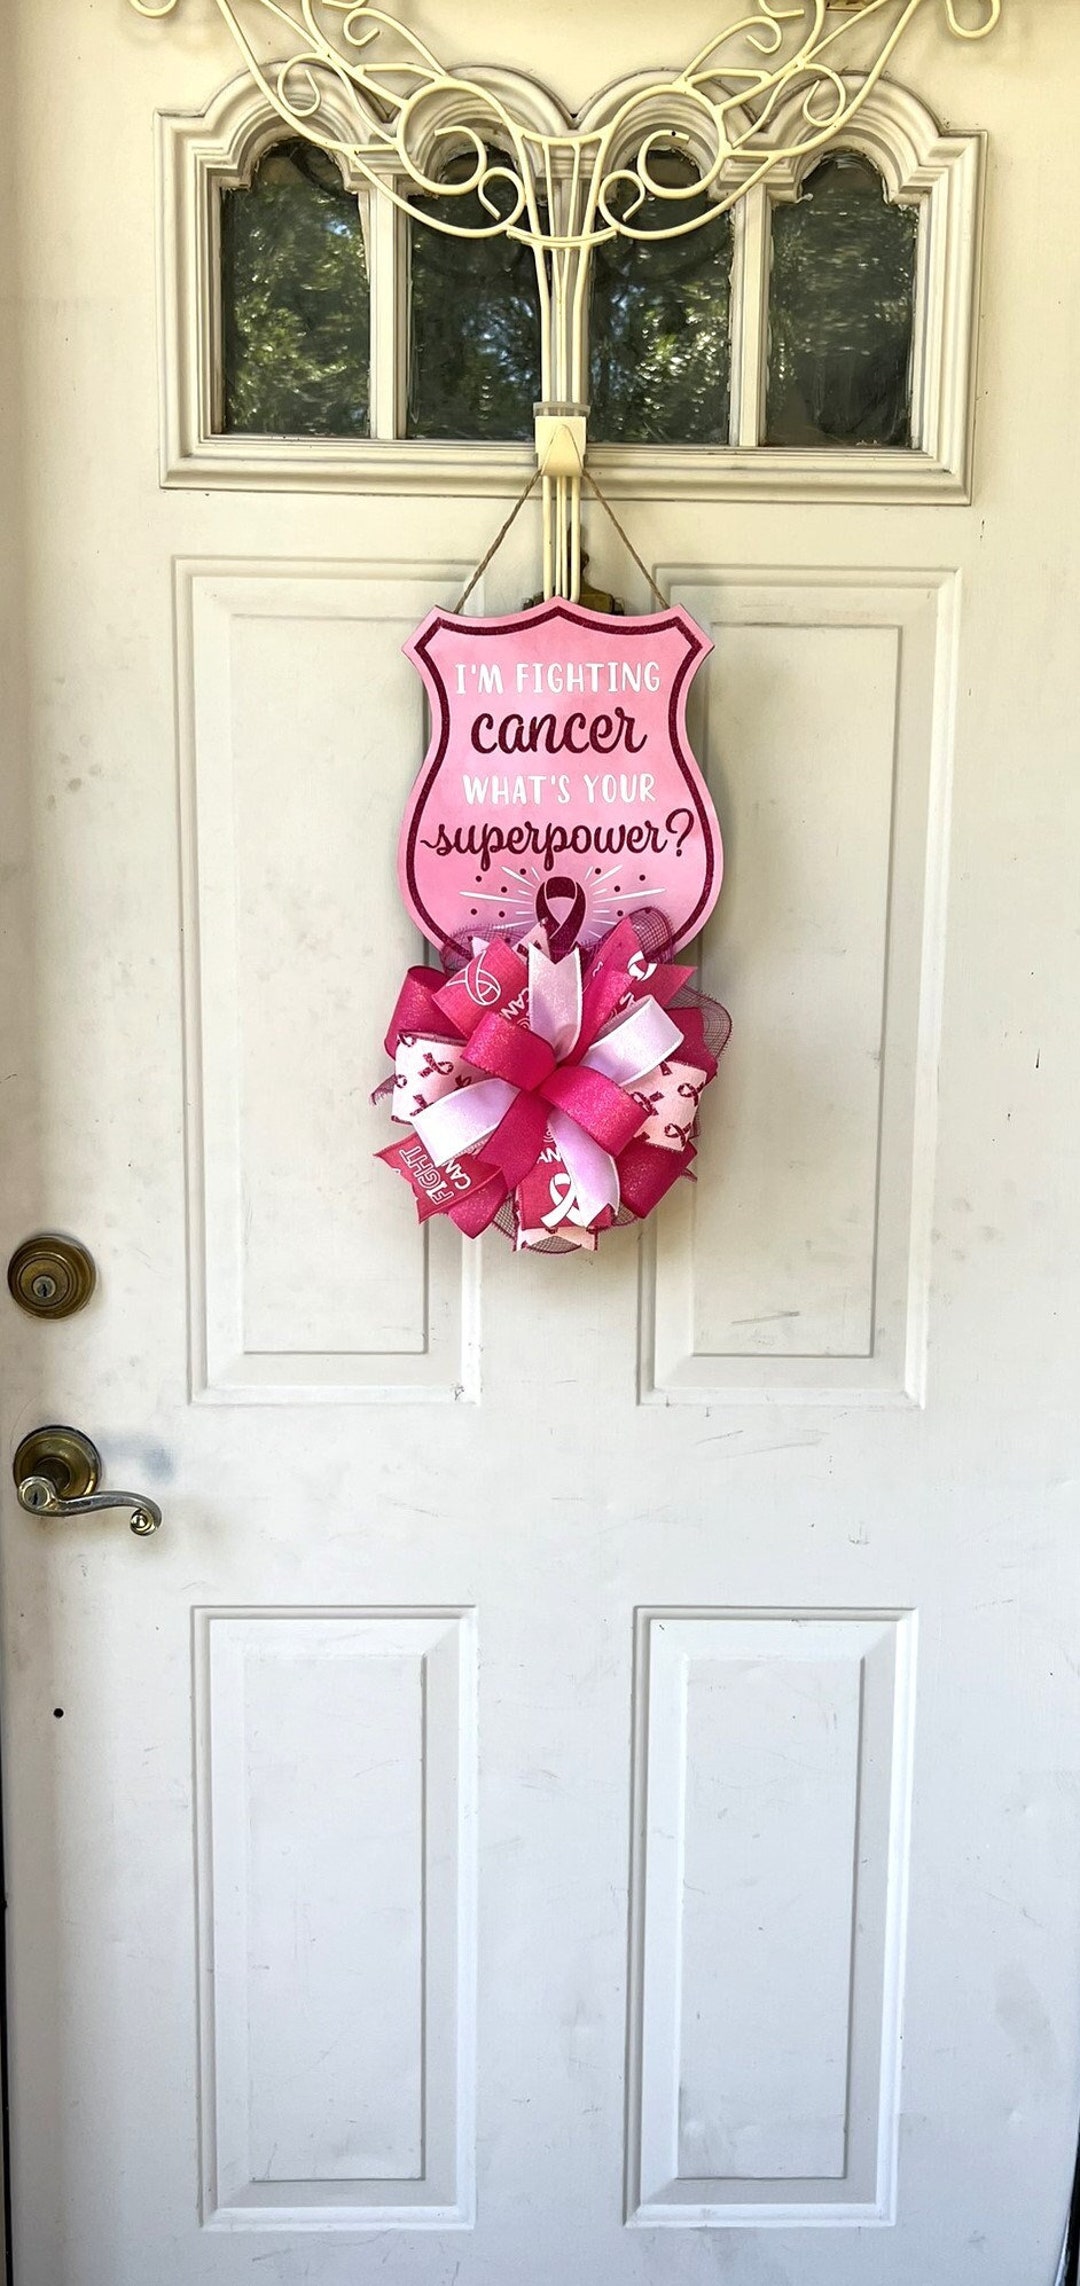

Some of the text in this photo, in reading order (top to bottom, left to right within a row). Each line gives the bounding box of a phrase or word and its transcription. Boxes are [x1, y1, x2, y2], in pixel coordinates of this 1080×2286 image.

[455, 661, 661, 695] I'M FIGHTING
[470, 706, 648, 754] cancer
[462, 772, 657, 805] WHAT'S YOUR
[419, 807, 695, 872] superpower?
[398, 1145, 455, 1206] FIGHT
